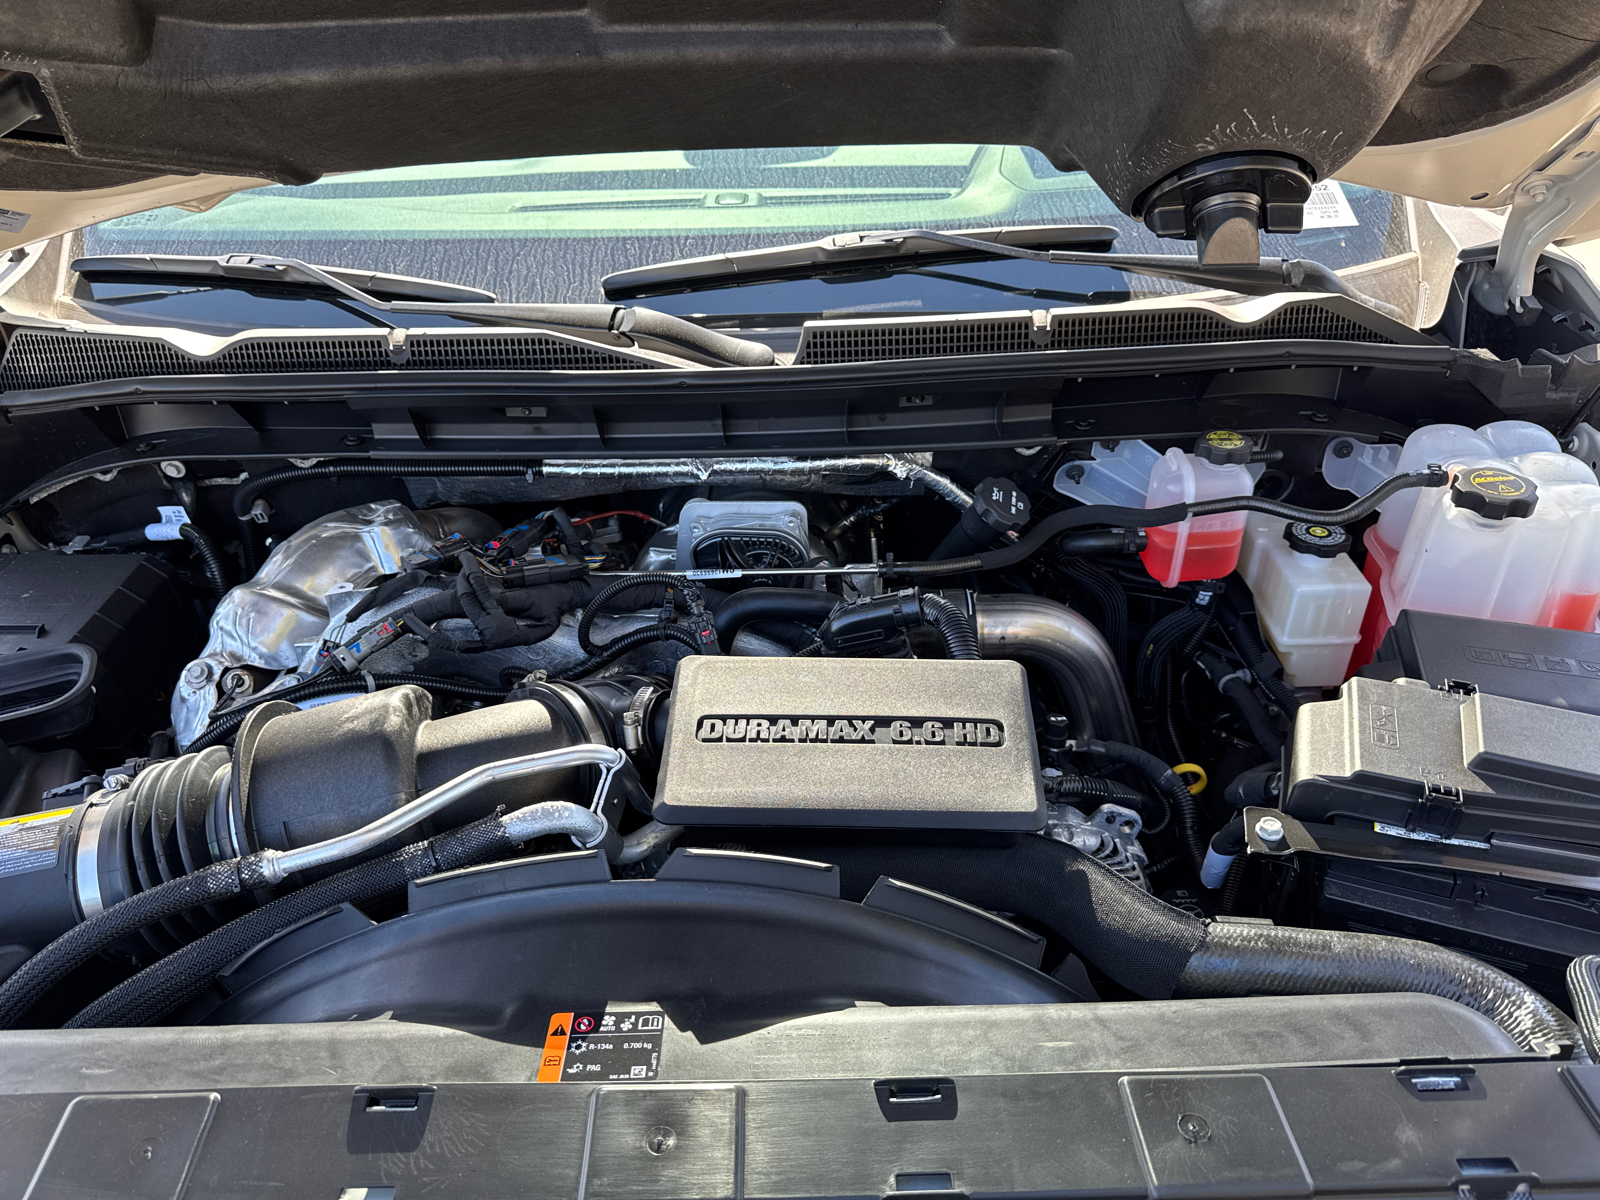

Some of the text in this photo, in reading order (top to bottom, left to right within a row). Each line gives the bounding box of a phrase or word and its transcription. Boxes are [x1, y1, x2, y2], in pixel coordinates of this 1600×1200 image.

[701, 718, 1001, 745] DURAMAX 6.6 HD
[586, 1064, 601, 1072] PAG
